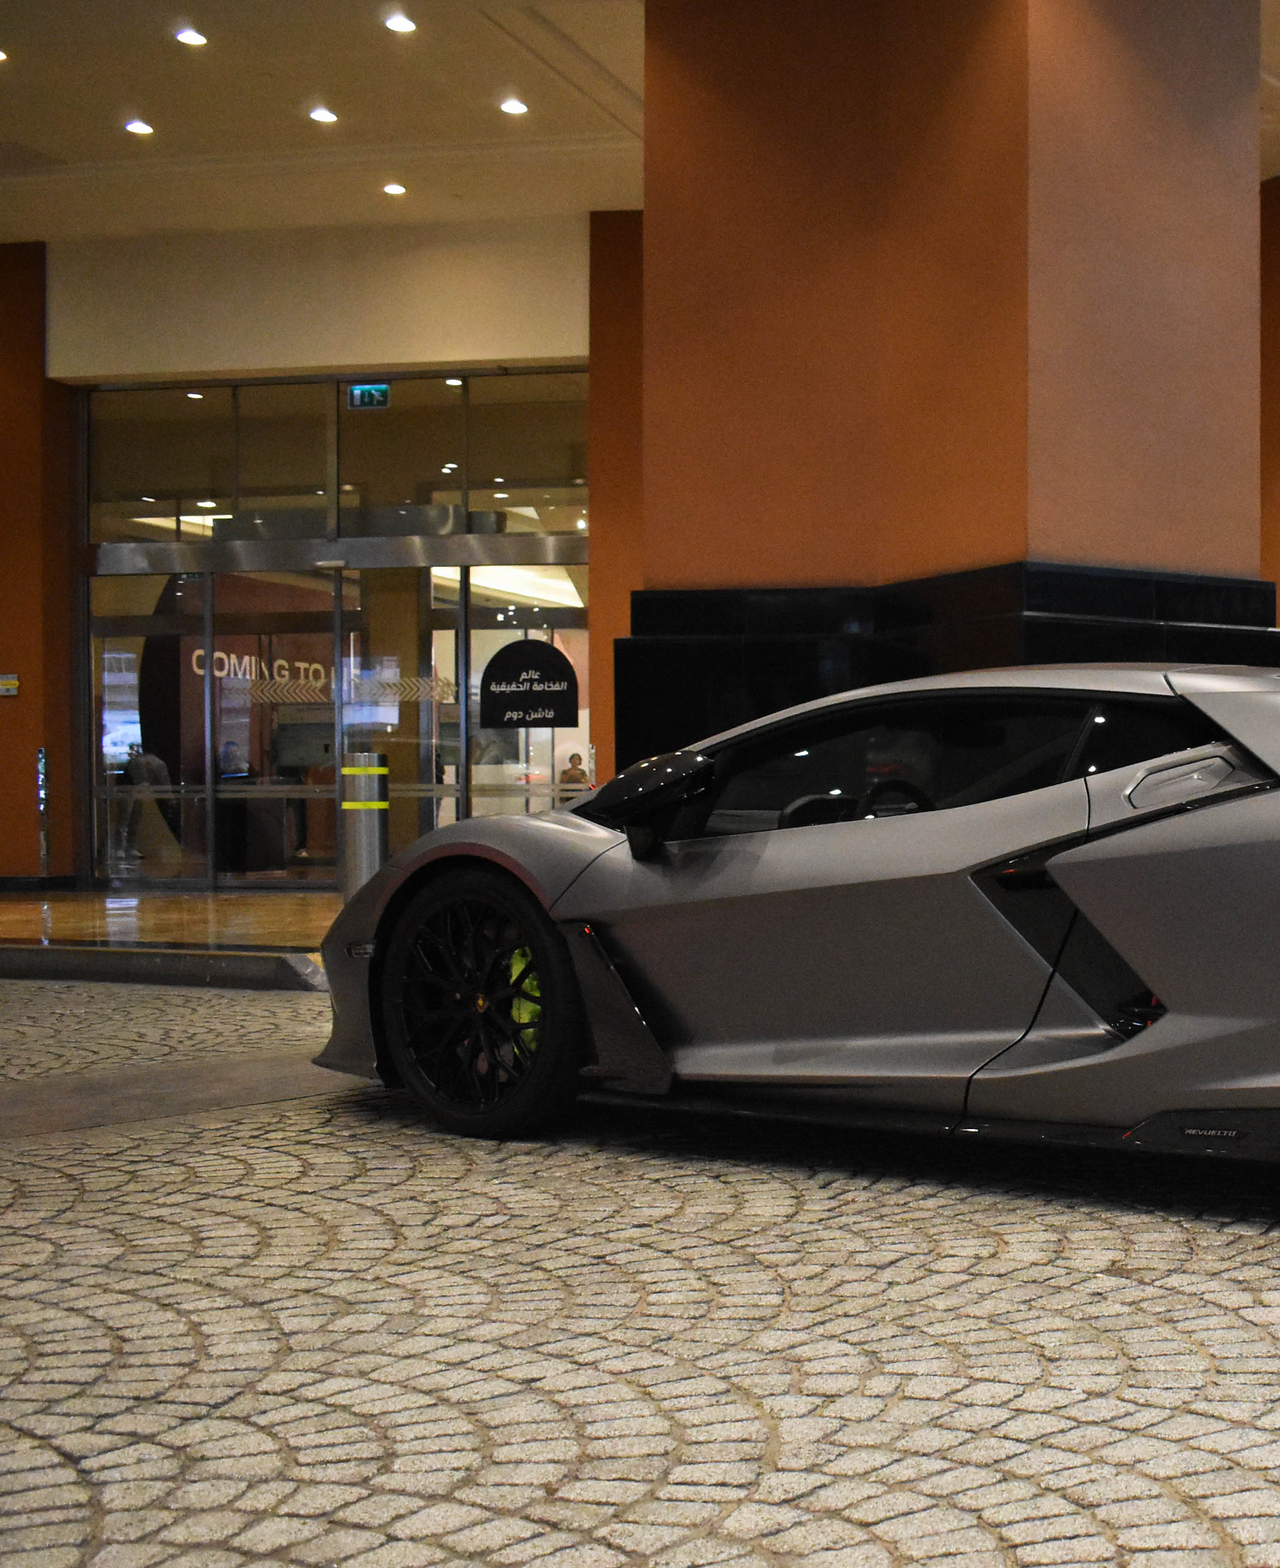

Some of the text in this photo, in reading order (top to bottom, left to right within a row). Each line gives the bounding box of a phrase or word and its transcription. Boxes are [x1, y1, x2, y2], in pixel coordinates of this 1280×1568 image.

[294, 661, 326, 687] TO
[520, 669, 541, 681] عالم
[489, 680, 530, 693] الحقيقية
[503, 708, 555, 722] فاشن دوم
[1184, 1129, 1237, 1137] REVUELTO
